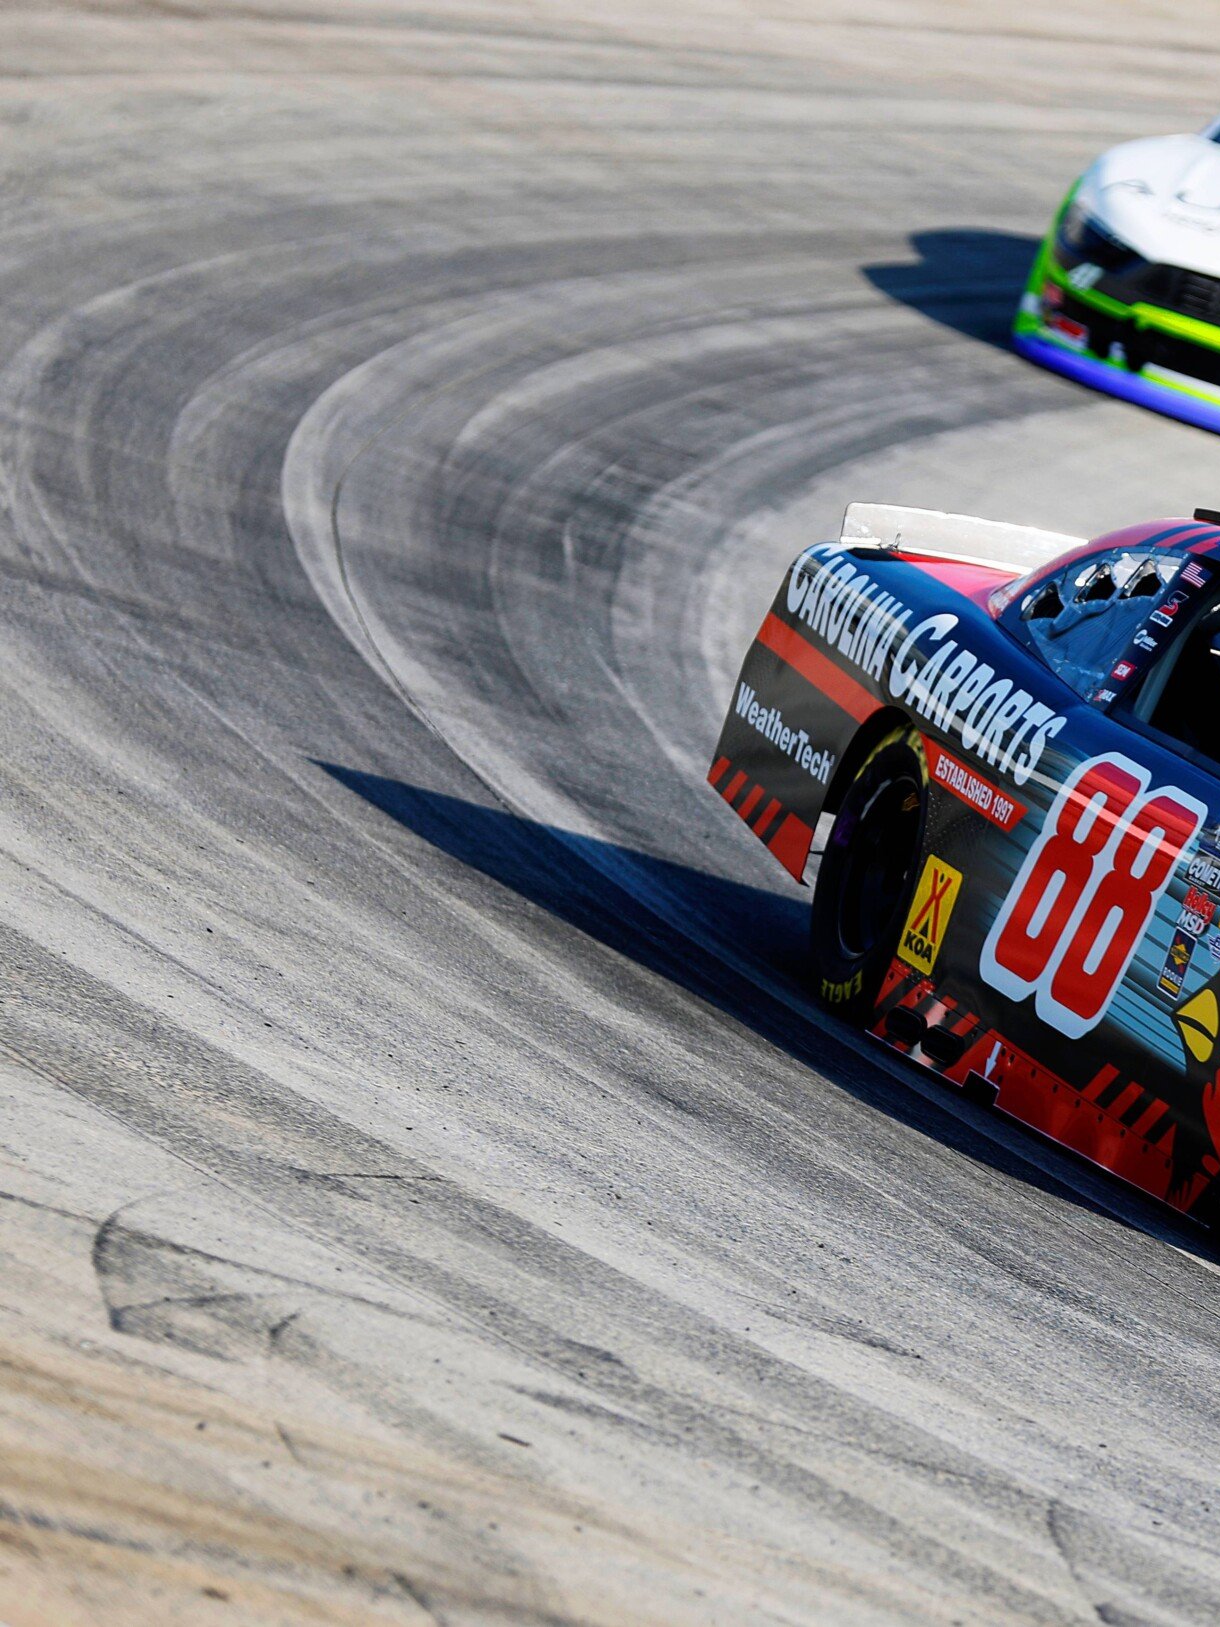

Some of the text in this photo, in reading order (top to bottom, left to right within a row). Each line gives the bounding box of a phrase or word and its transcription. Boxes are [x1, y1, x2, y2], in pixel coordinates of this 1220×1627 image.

[787, 542, 913, 682] CAROLINA
[889, 613, 1067, 786] CARPORTS
[735, 682, 835, 784] WeatherTech
[935, 754, 993, 811] ESTABLISHED
[991, 793, 1015, 824] 1997
[980, 753, 1208, 1039] 88
[1176, 910, 1205, 935] MSD
[904, 930, 937, 963] KOA
